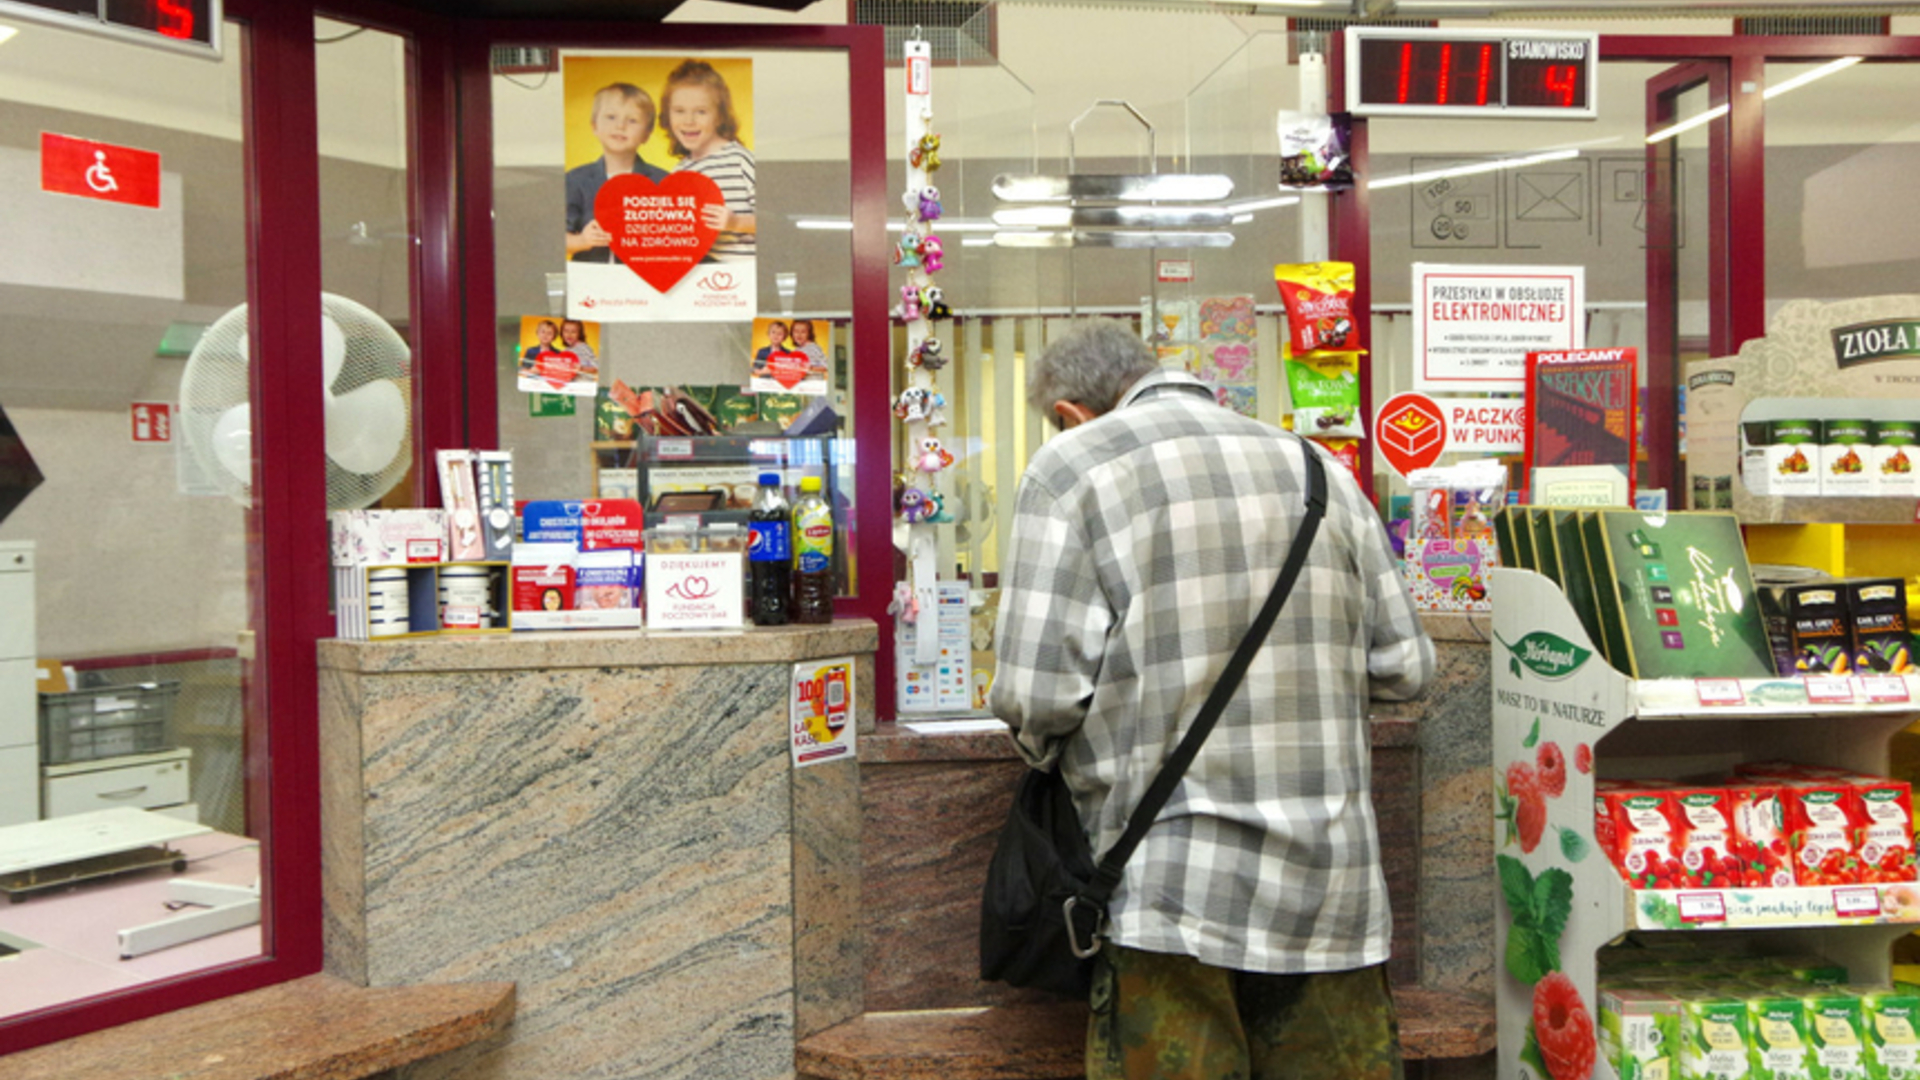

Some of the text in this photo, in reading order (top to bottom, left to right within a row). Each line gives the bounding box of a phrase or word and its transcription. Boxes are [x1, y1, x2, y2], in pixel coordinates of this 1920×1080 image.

[1508, 40, 1586, 60] STANOWISKO
[1544, 65, 1578, 107] 4
[1427, 178, 1451, 199] 100
[622, 196, 697, 209] PODZIEL SIĘ
[1454, 200, 1472, 214] 50
[624, 207, 697, 222] ZŁOTÓWKĄ
[625, 223, 695, 234] DZIECIAKOM
[621, 235, 700, 247] NA ZDRÓWKO
[1432, 286, 1565, 301] PRZESYŁKI W OBSŁUDZE
[1432, 301, 1566, 322] ELEKTRONICZNEJ
[1839, 326, 1910, 359] ZIOŁA
[1537, 349, 1625, 364] POLECAMY
[1453, 429, 1526, 444] W PUNK
[661, 560, 726, 572] DZIĘKUJEMY
[672, 603, 716, 611] FUNDACJA
[662, 611, 708, 620] POCZTOWY
[798, 678, 825, 702] 100
[1497, 688, 1606, 727] MASZ TO W NATURZE
